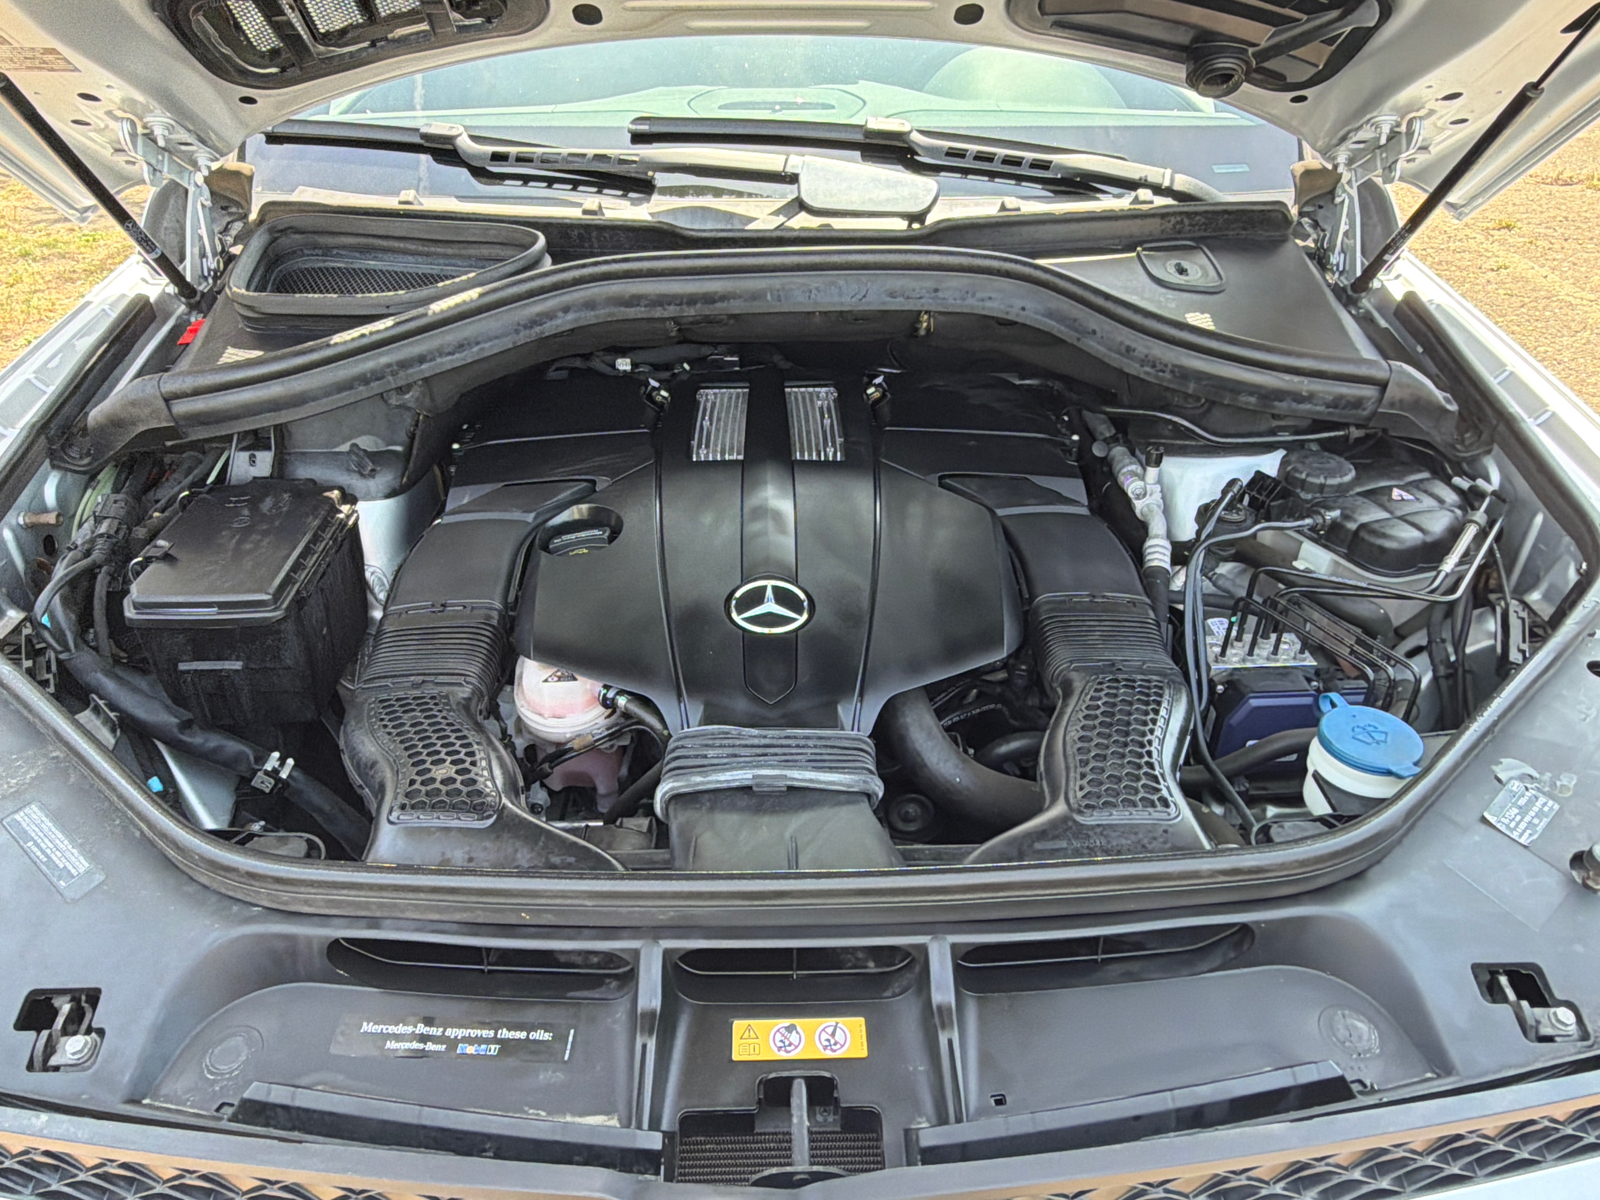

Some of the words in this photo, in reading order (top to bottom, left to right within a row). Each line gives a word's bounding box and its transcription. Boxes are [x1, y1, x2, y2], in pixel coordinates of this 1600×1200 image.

[360, 1021, 443, 1036] Mercedes-Benz
[444, 1027, 495, 1039] approves
[497, 1027, 527, 1039] these
[529, 1029, 553, 1040] oils:
[384, 1040, 447, 1052] Mercedes-Benz
